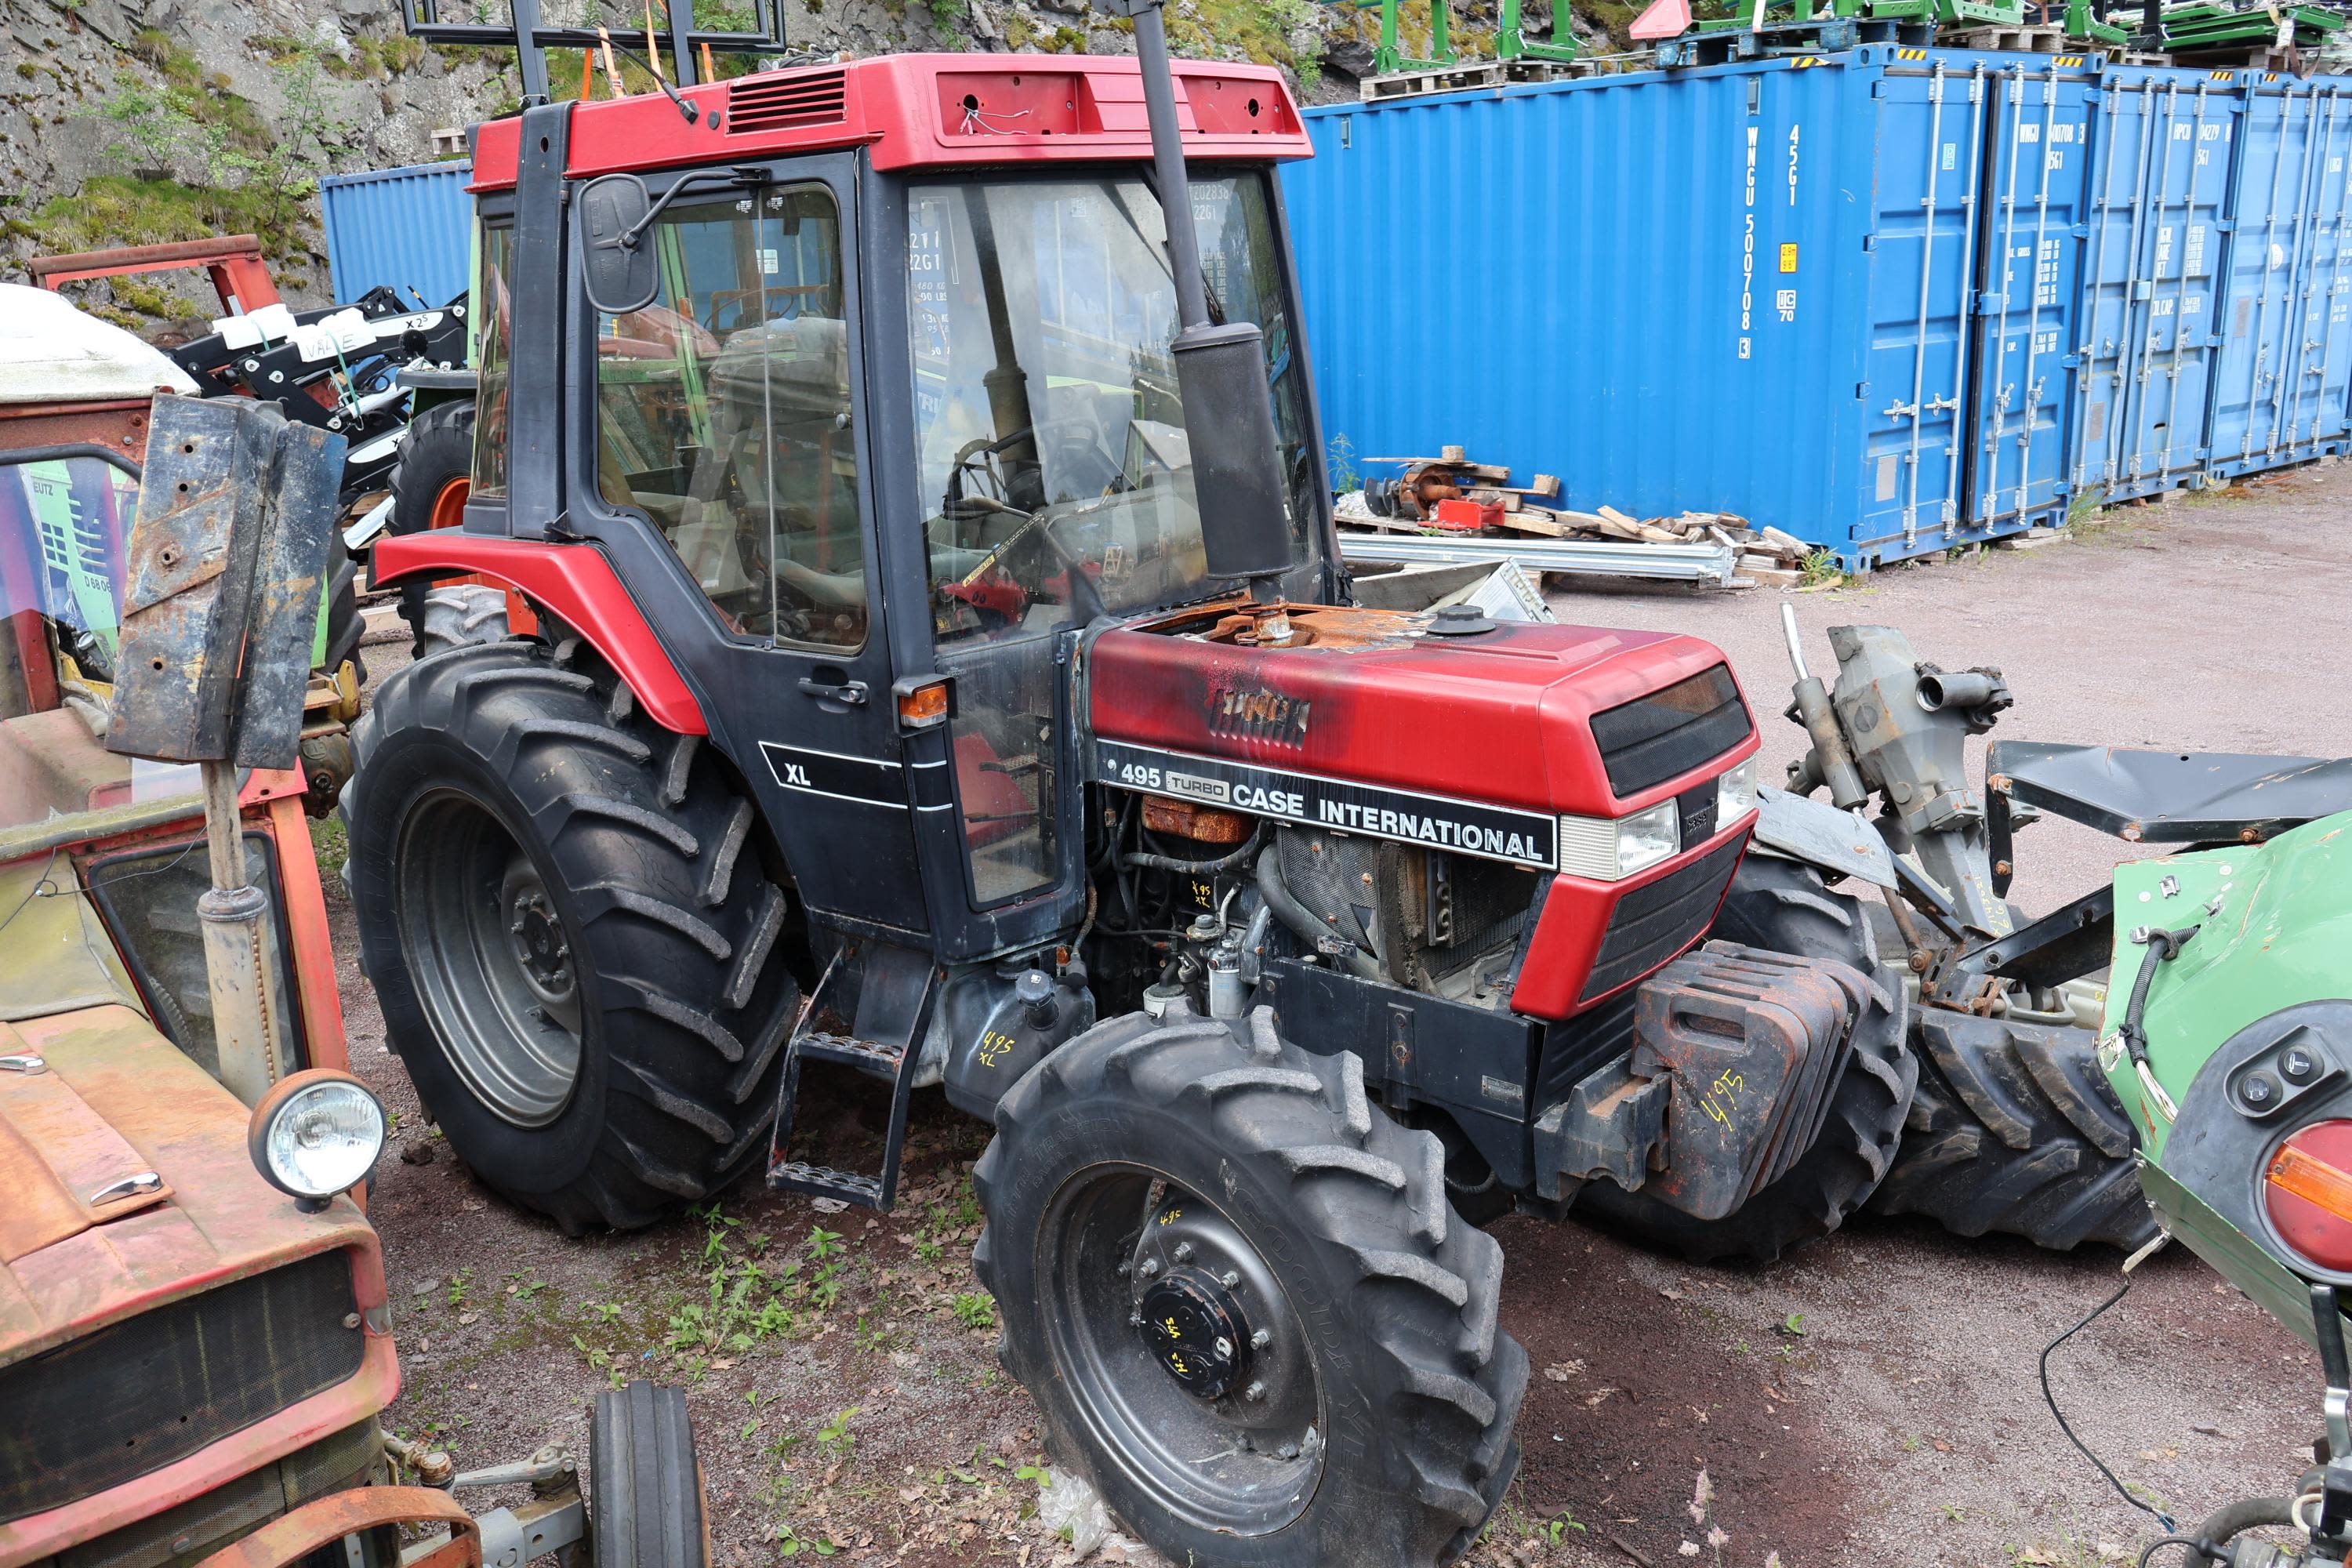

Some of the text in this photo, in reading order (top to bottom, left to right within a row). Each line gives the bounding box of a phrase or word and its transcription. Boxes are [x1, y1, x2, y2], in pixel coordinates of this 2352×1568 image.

[2020, 124, 2039, 143] WNGU
[2050, 124, 2074, 143] 00708
[2200, 124, 2220, 141] 04279
[1789, 125, 1799, 206] 45G1
[2197, 149, 2209, 165] 5G1
[1739, 126, 1759, 359] WNGU 500708 3
[2158, 244, 2171, 261] ARE
[1780, 310, 1794, 322] 70
[33, 481, 53, 496] EUTZ
[785, 762, 811, 787] XL
[1121, 764, 1544, 862] 495 TURBO CASE INTERNATIONAL
[983, 1031, 1015, 1054] 495
[978, 1051, 995, 1067] XL
[1700, 1068, 1743, 1132] 495
[1160, 1209, 1181, 1227] 495
